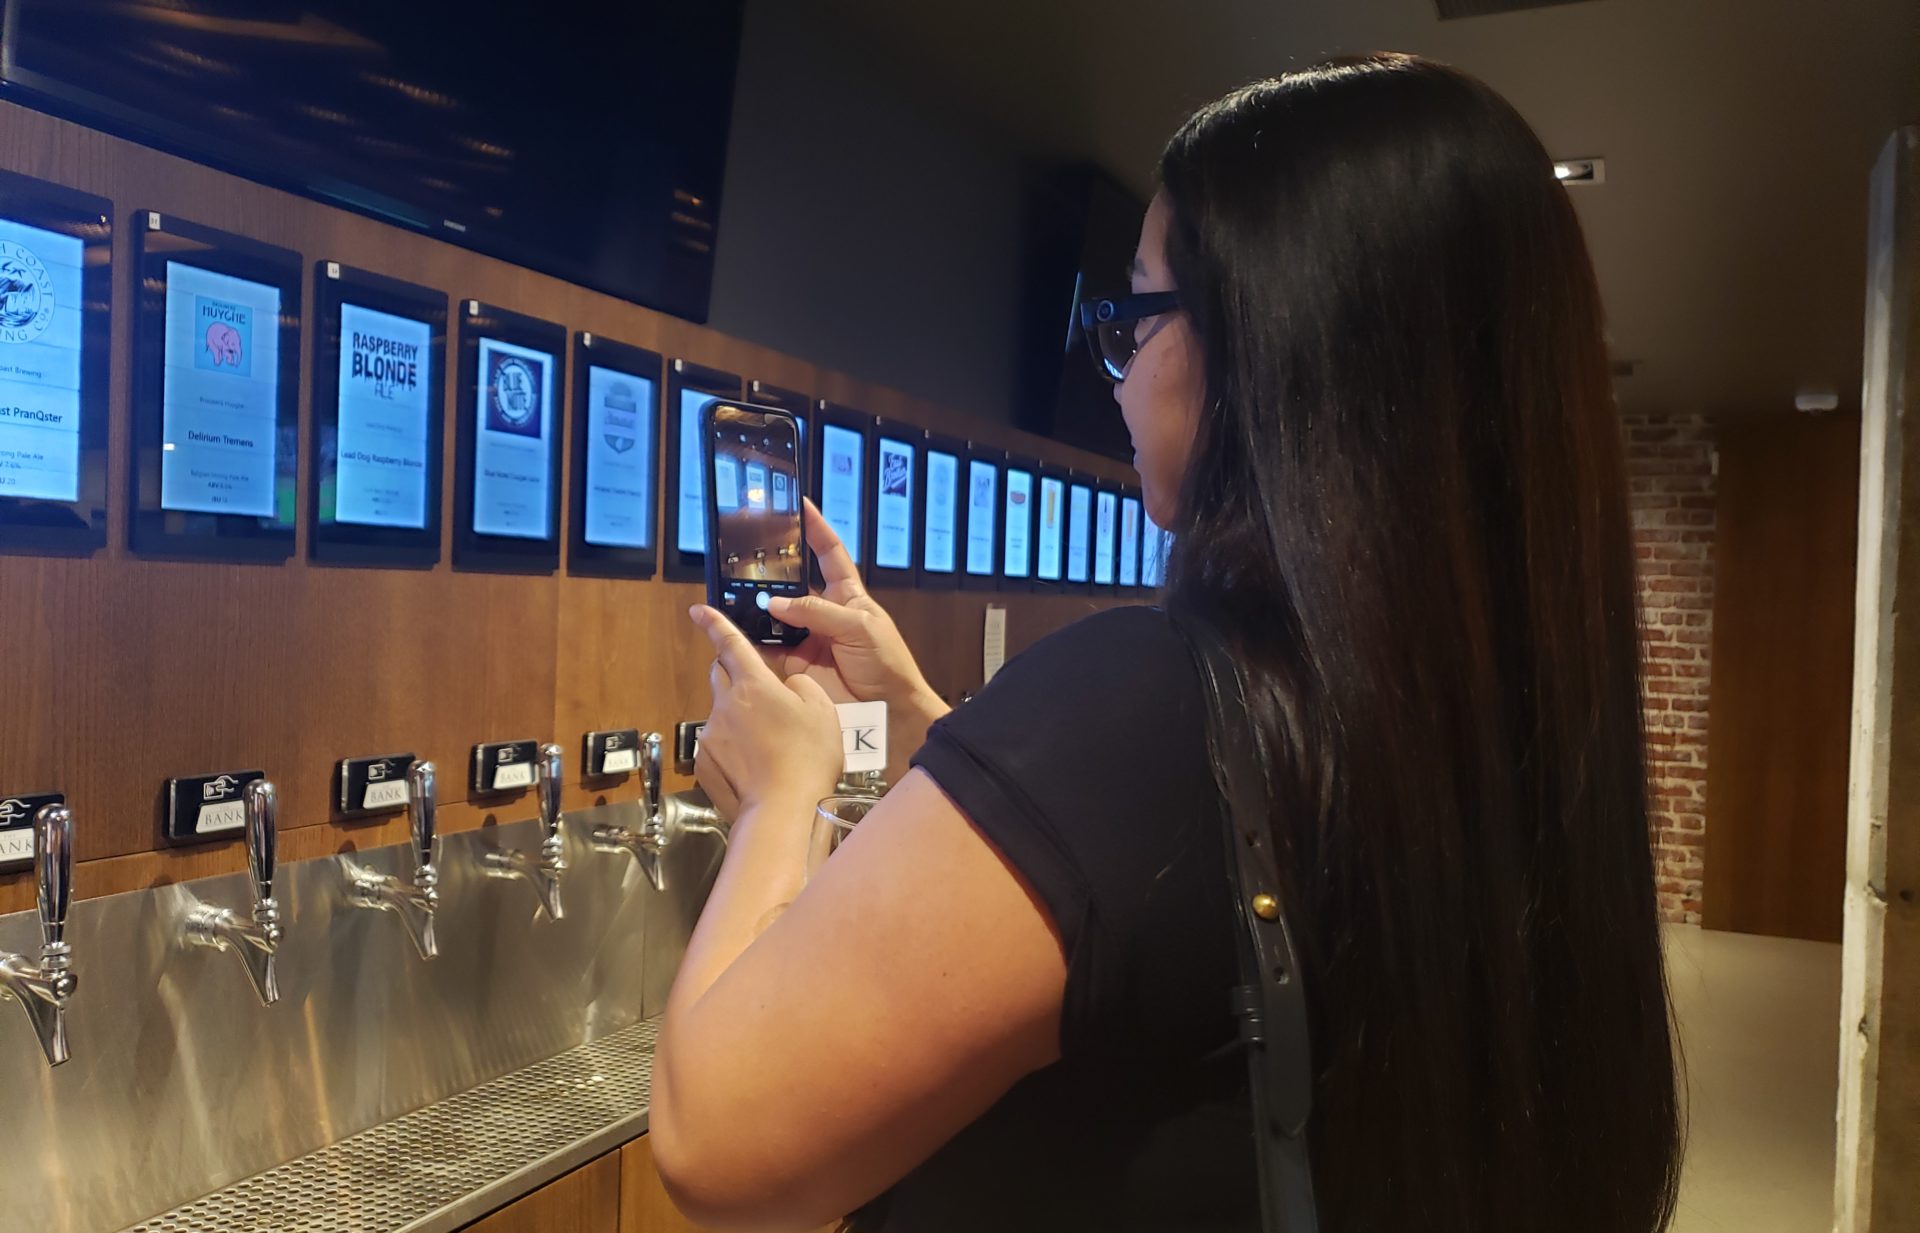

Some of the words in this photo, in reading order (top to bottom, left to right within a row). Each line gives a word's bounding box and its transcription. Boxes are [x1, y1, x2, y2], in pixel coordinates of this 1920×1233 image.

[16, 248, 53, 297] COAST
[352, 332, 418, 361] RASPBERRY
[351, 351, 417, 389] BLONDE
[14, 407, 63, 424] PranQster
[188, 430, 221, 445] Delirium
[223, 435, 254, 448] Tremens
[371, 786, 403, 804] BANK
[205, 809, 244, 826] BANK
